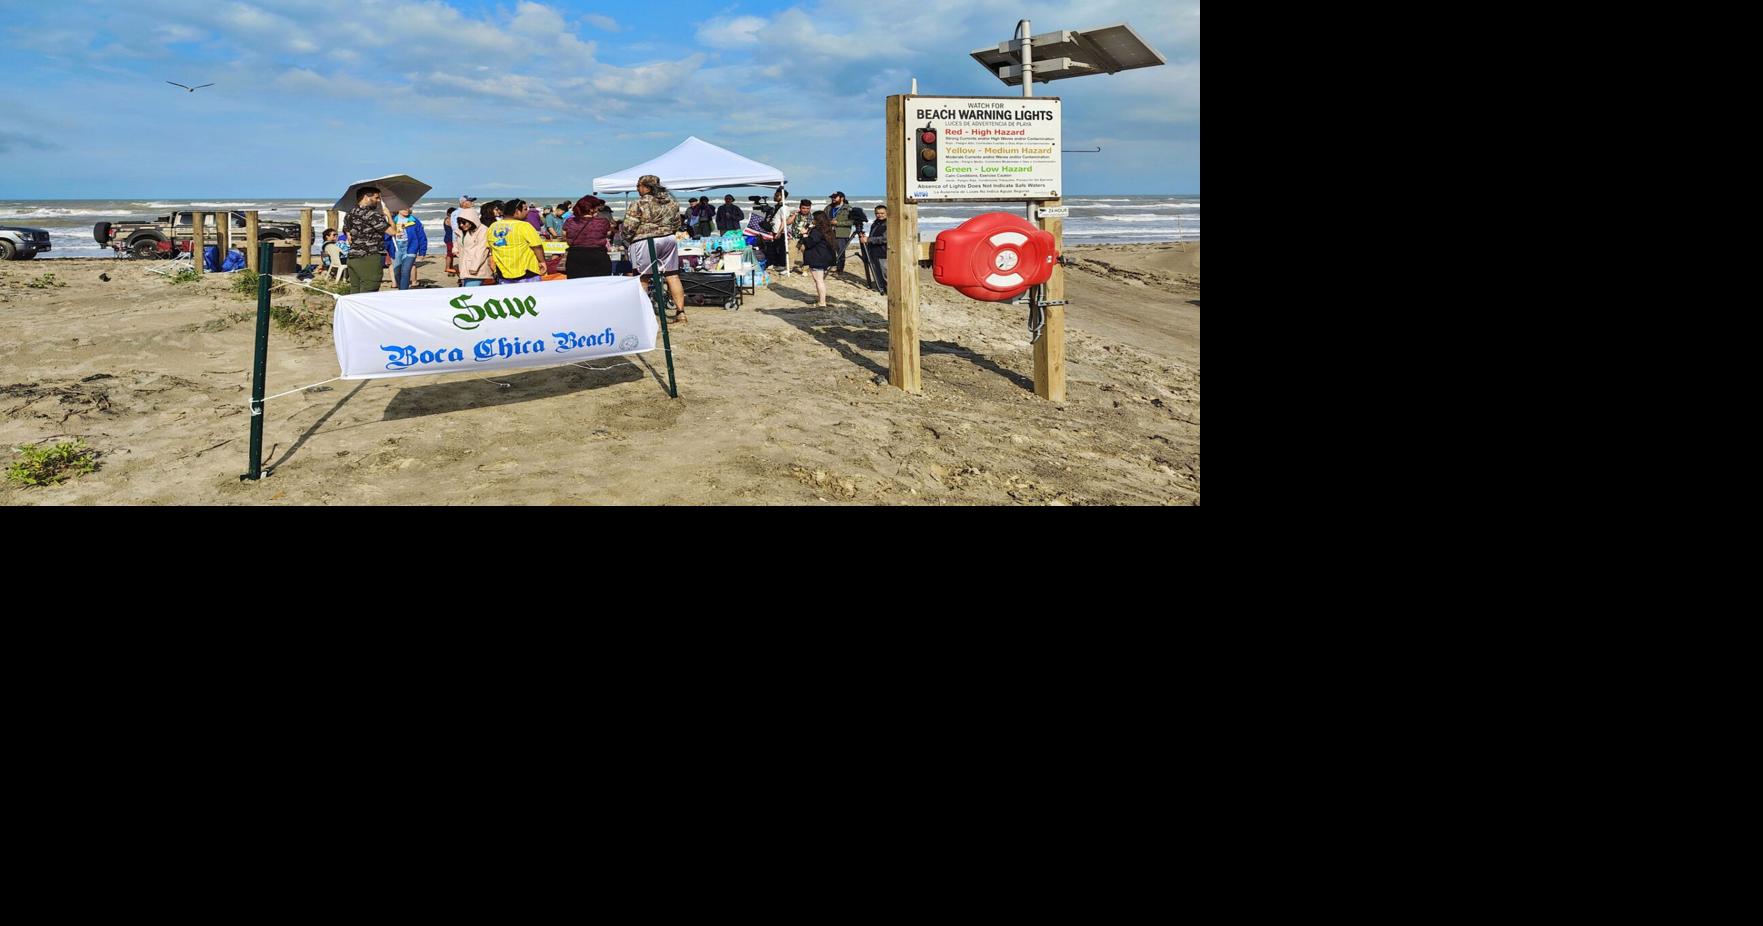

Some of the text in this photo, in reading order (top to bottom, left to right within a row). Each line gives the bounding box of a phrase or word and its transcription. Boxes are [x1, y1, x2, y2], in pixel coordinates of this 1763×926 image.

[916, 109, 1054, 121] BEACH WARNING LIGHTS
[971, 128, 992, 136] High
[994, 128, 1025, 136] Hazard
[1001, 165, 1033, 173] Hazard
[449, 293, 540, 331] Save
[380, 344, 464, 371] Boca
[473, 337, 546, 363] Chica
[551, 327, 616, 354] Beach
